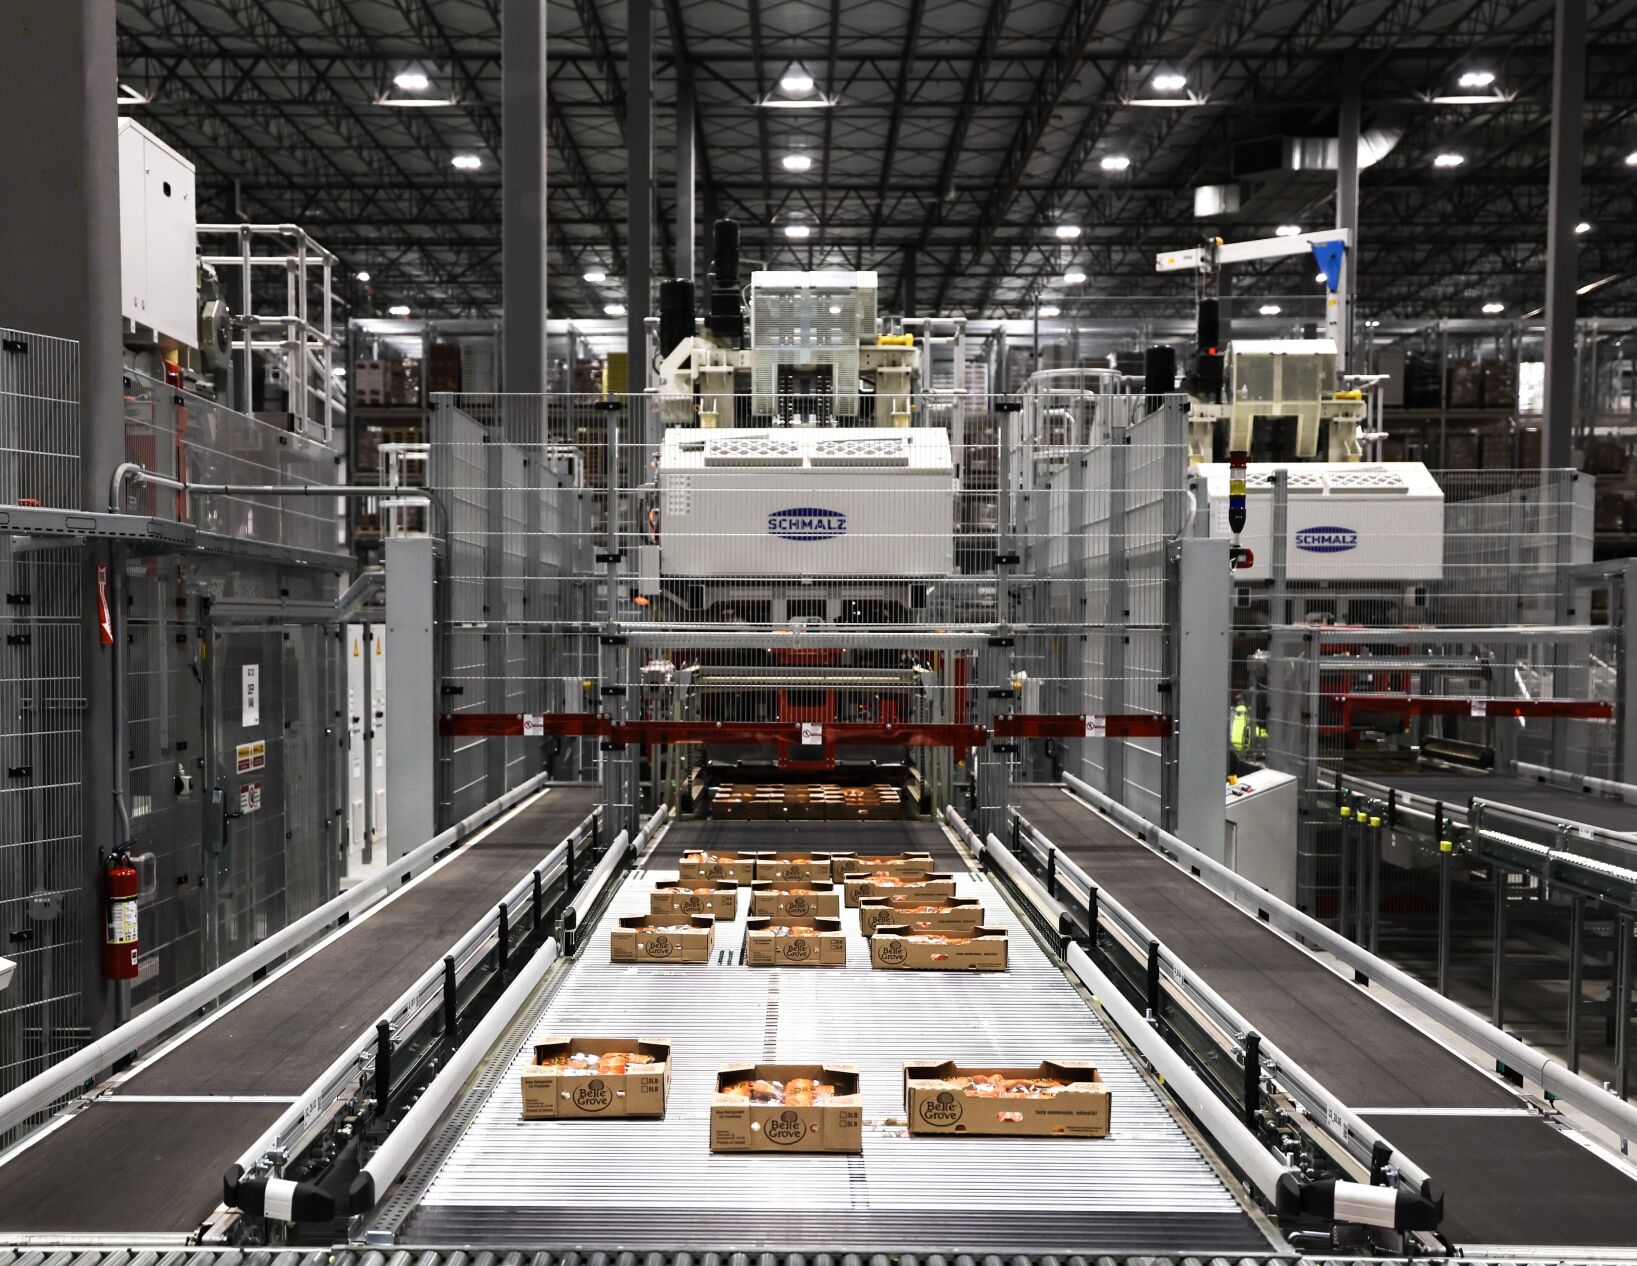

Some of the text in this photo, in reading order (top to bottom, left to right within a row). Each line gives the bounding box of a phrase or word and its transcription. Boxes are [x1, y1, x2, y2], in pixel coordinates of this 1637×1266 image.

[768, 518, 847, 530] SCHMALZ
[1295, 534, 1358, 545] SCHMALZ
[854, 888, 871, 896] Belle
[650, 941, 669, 949] Belle
[579, 1088, 606, 1098] Belle
[577, 1097, 607, 1106] Grove
[927, 1101, 955, 1111] Belle
[924, 1110, 957, 1120] Grove
[771, 1119, 800, 1130] Belle
[768, 1129, 801, 1138] Grove
